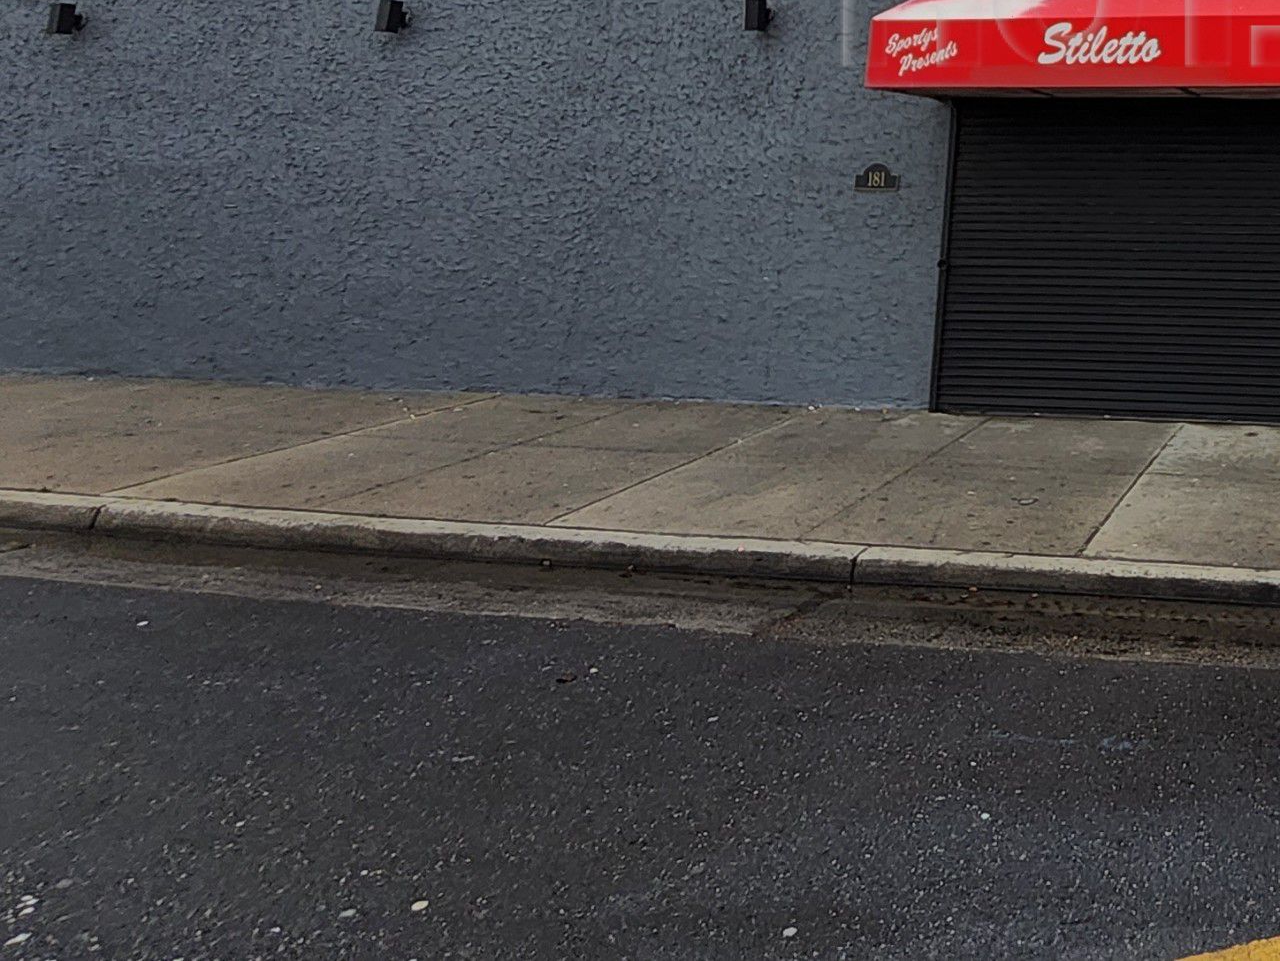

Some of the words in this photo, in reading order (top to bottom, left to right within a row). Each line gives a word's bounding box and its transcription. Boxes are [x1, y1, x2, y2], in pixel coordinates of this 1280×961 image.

[898, 41, 958, 77] Presents
[1038, 22, 1161, 64] Stiletto
[867, 171, 886, 187] 181
